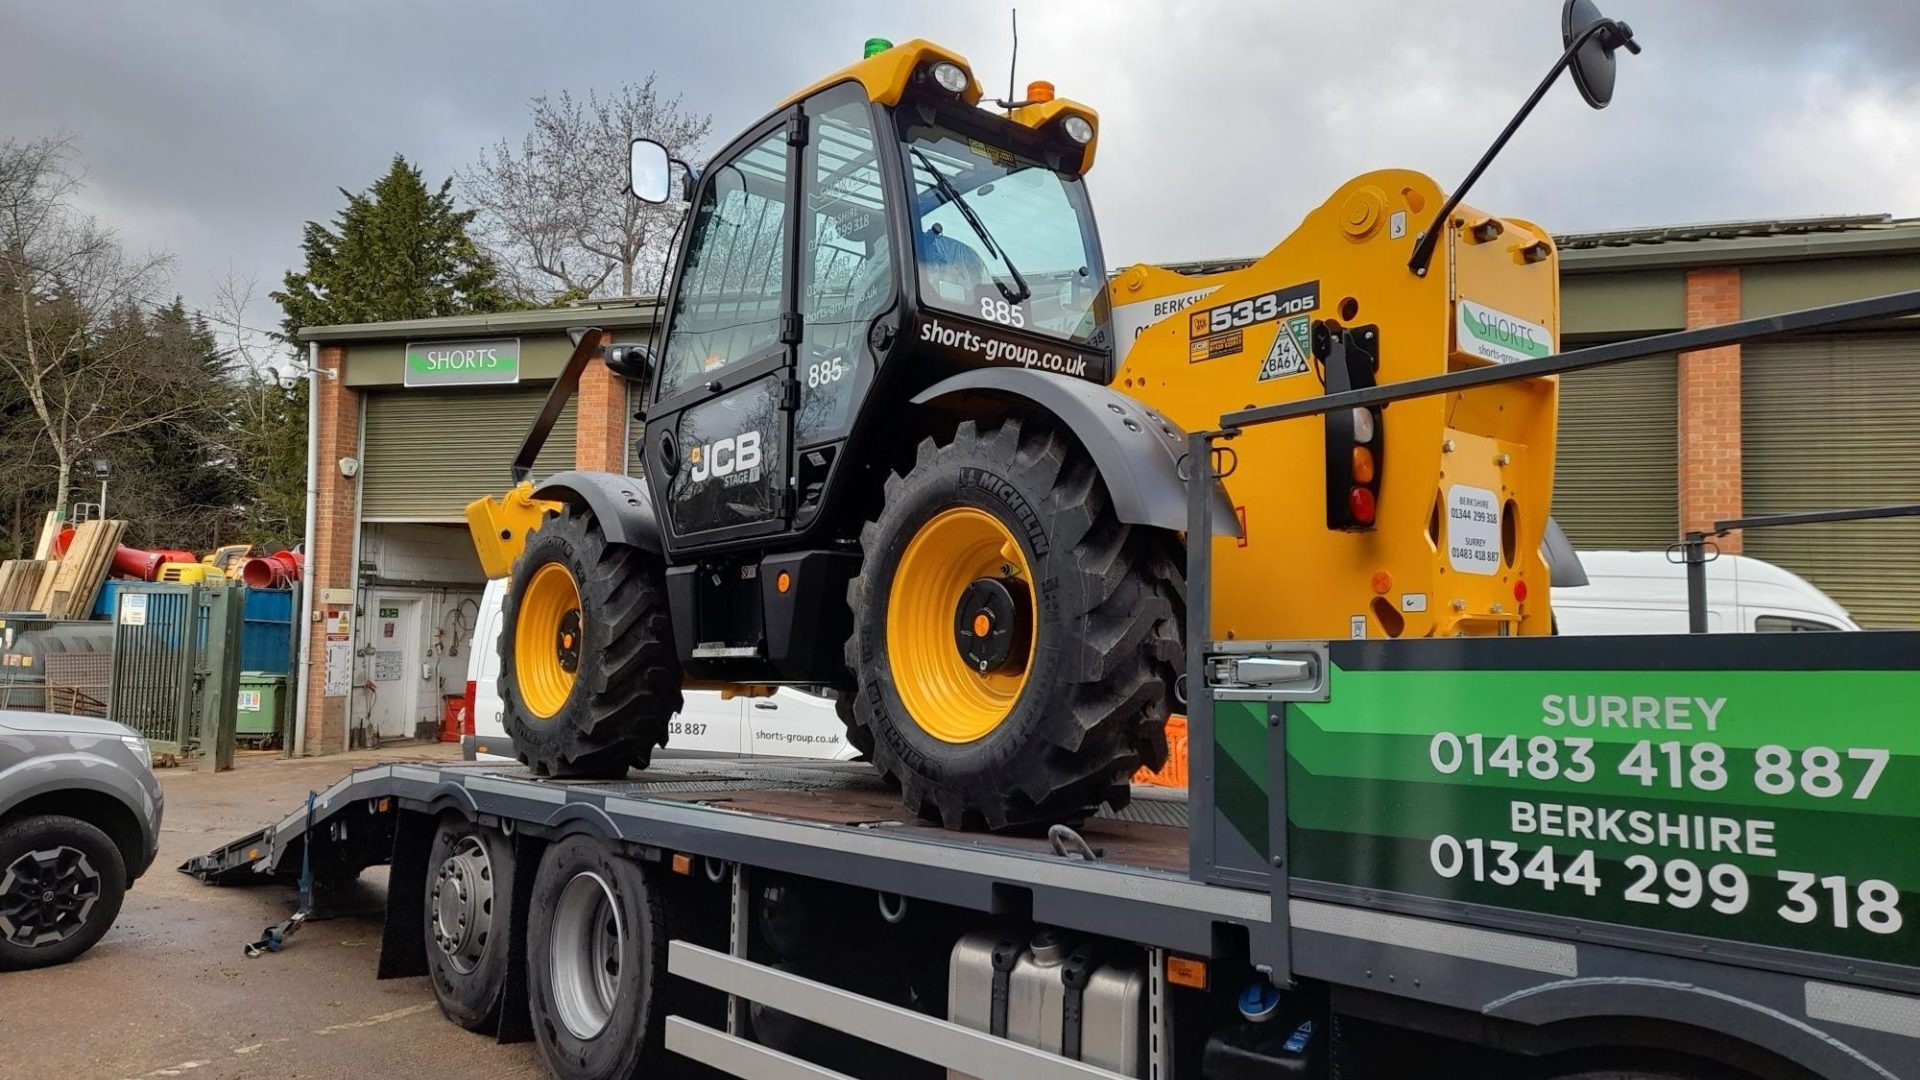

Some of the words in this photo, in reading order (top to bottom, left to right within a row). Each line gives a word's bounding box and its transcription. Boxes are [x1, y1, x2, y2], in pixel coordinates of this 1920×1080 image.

[853, 214, 870, 232] 318
[980, 296, 1025, 329] 885
[1154, 292, 1214, 317] BERKS
[1478, 311, 1536, 352] SHORTS
[427, 348, 497, 370] SHORTS
[920, 319, 1088, 377] shorts-group.co.uk
[1277, 341, 1291, 357] 14
[808, 356, 842, 388] 885
[691, 430, 761, 482] JCB
[723, 470, 749, 488] STAGE
[978, 471, 1050, 556] MICHELIN
[1459, 496, 1490, 509] BERKSHIRE
[1450, 507, 1472, 520] 01344
[1473, 510, 1486, 522] 299
[1486, 512, 1498, 524] 318
[1451, 547, 1473, 560] 01483
[1474, 550, 1486, 561] 418
[1487, 551, 1499, 562] 887
[1465, 537, 1487, 547] SURREY
[1541, 694, 1728, 731] SURREY
[684, 723, 707, 736] 887
[755, 730, 840, 745] shorts-group.co.uk
[1429, 731, 1597, 783] 01483
[1617, 739, 1729, 791] 418
[1753, 744, 1891, 800] 887
[1510, 800, 1777, 858] BERKSHIRE
[1429, 834, 1602, 897] 01344
[1623, 854, 1750, 915] 299
[1776, 869, 1903, 935] 318
